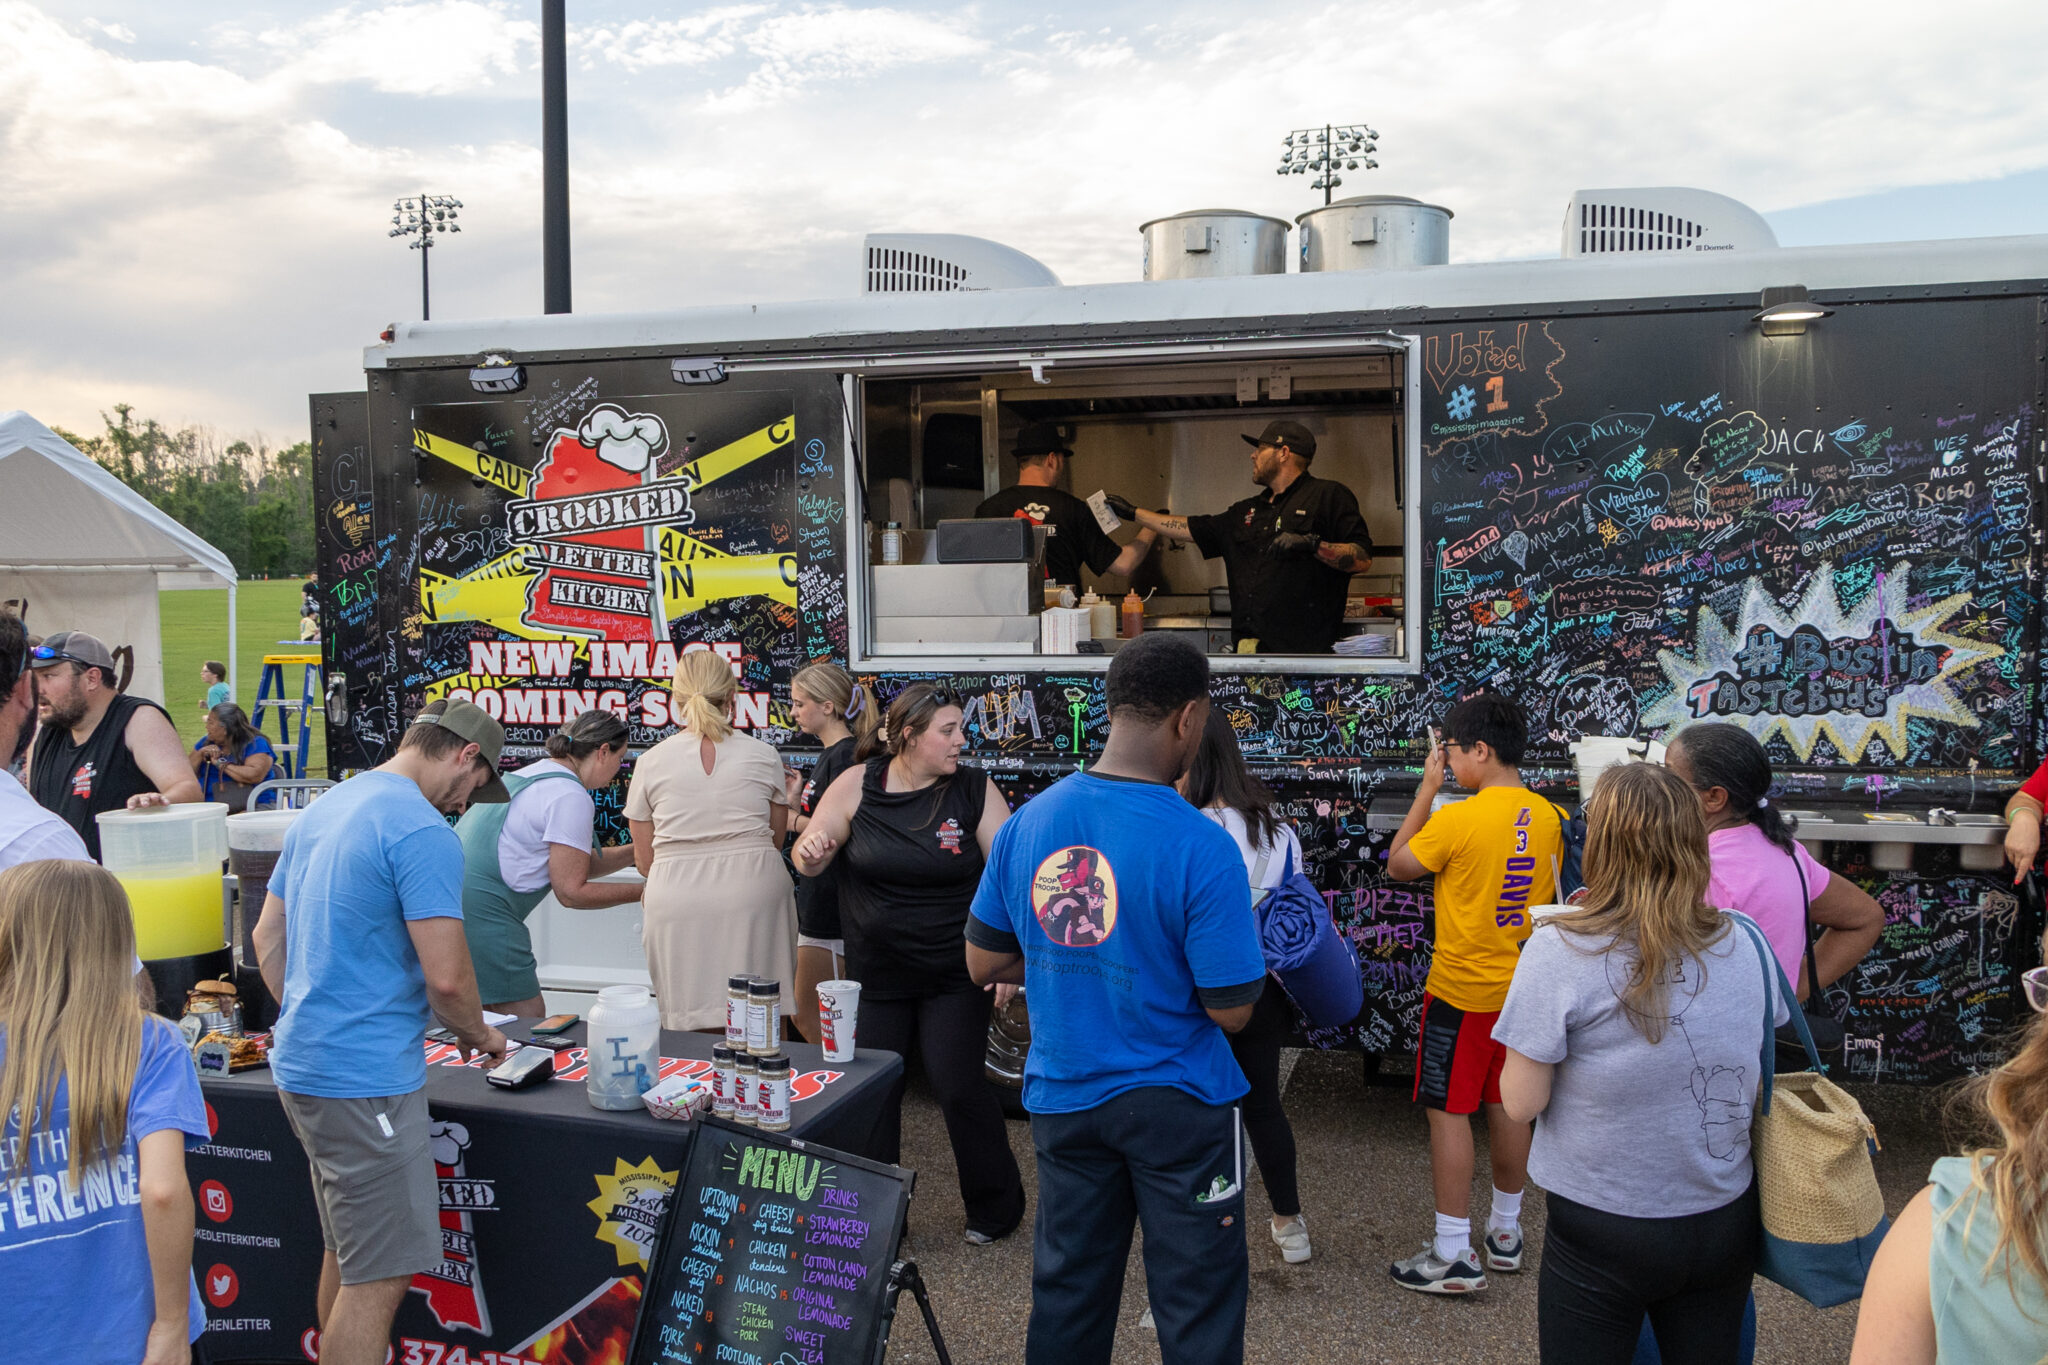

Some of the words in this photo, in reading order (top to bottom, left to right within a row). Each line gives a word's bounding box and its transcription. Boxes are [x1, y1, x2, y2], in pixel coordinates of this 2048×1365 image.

[1431, 415, 1525, 435] @mississippimagazine
[1759, 428, 1825, 455] JACK
[1934, 434, 1968, 451] WES
[1929, 463, 1969, 480] MADI
[1600, 486, 1659, 516] Michaela
[1754, 478, 1822, 509] Trinity
[513, 487, 684, 536] CROOKED
[799, 526, 830, 543] Steven
[810, 538, 830, 549] was
[549, 545, 650, 576] LETTER
[1646, 542, 1683, 562] Uncle
[1444, 571, 1462, 581] The
[551, 581, 649, 612] KITCHEN
[804, 610, 824, 623] CLK
[807, 636, 826, 644] the
[469, 641, 575, 677] NEW
[807, 645, 835, 659] Best
[1209, 684, 1247, 698] Wilson
[641, 691, 770, 727] SN
[1302, 722, 1322, 736] CLK
[1301, 736, 1361, 758] Sarah
[1307, 767, 1340, 781] Sarah
[1515, 829, 1528, 854] 3
[1035, 883, 1061, 892] TROOPS
[1039, 876, 1057, 884] POOP
[1495, 857, 1536, 928] DAVIS
[1845, 1033, 1882, 1052] Emma
[619, 1172, 661, 1186] MISSISSIPPI
[738, 1145, 821, 1201] MENU
[623, 1186, 669, 1214] Best
[700, 1187, 740, 1214] UPTOWN
[823, 1188, 859, 1208] DRINKS
[759, 1203, 795, 1225] CHEESY
[689, 1221, 721, 1248] KICKIN
[809, 1214, 870, 1239] STRAWBERRY
[749, 1240, 787, 1260] CHICKEN
[804, 1231, 864, 1249] LEMONADE
[681, 1256, 718, 1281] CHEESY
[803, 1253, 837, 1270] COTTON
[838, 1260, 868, 1280] CANDY
[734, 1274, 777, 1300] NACHOS
[779, 1289, 788, 1300] 15
[802, 1270, 857, 1292] LEMONADE
[671, 1290, 704, 1316] NAKED
[792, 1287, 836, 1310] ORIGINAL
[798, 1305, 853, 1331] LEMONADE
[659, 1324, 686, 1347] PORK
[785, 1325, 827, 1349] SWEET
[715, 1343, 762, 1365] FOOTLONG
[799, 1347, 824, 1364] TEA
